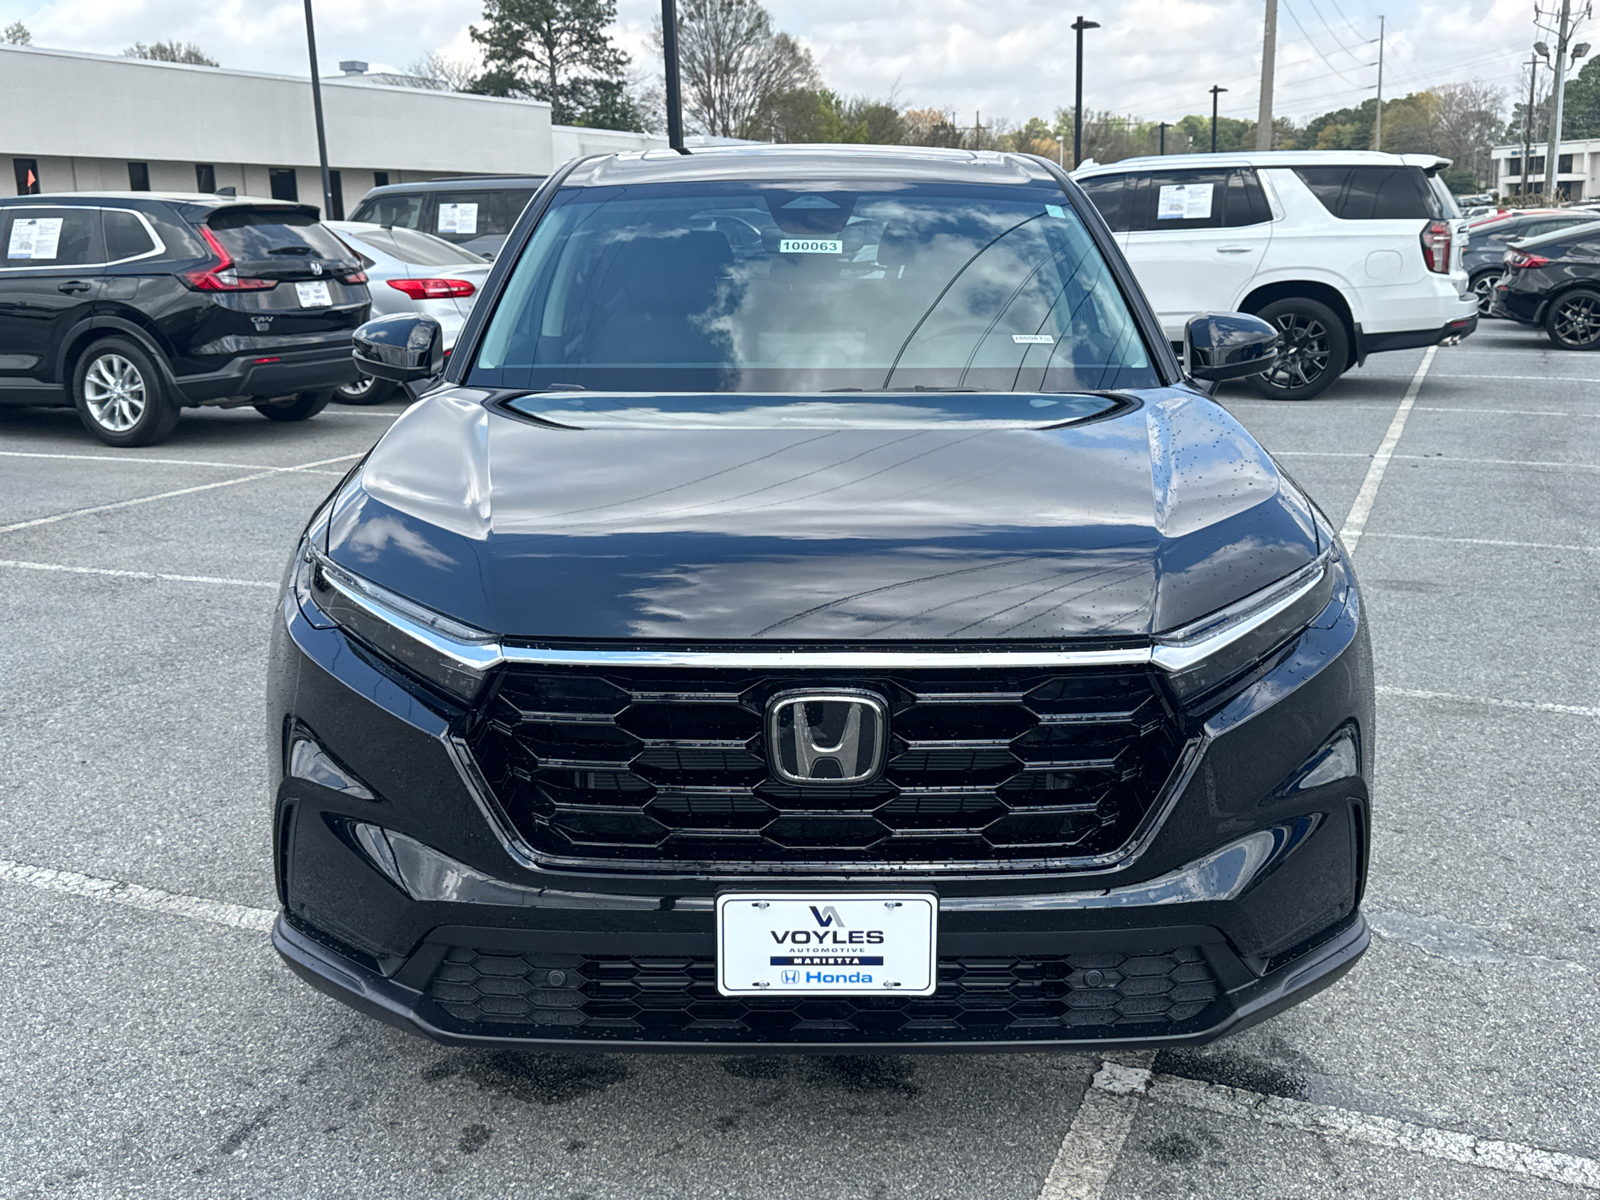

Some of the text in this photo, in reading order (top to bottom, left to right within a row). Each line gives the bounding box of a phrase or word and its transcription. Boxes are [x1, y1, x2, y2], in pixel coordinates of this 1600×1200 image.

[783, 241, 838, 251] 100063
[770, 930, 884, 944] VOYLES
[806, 971, 873, 983] Honda
